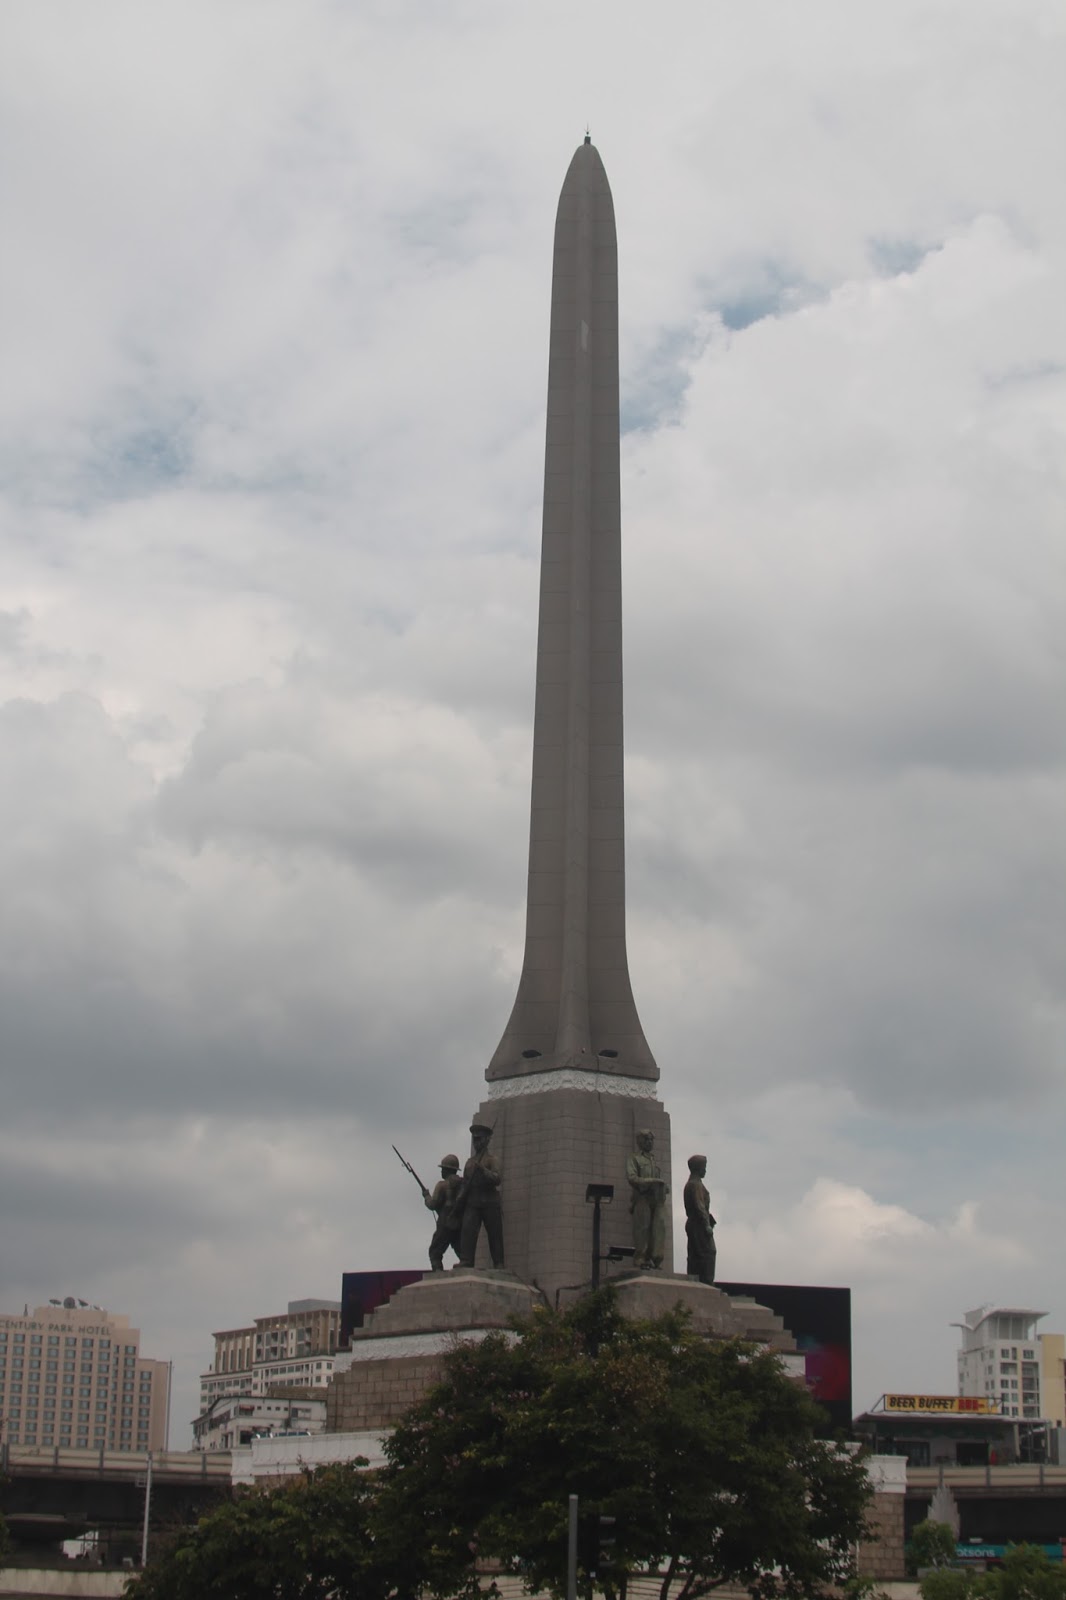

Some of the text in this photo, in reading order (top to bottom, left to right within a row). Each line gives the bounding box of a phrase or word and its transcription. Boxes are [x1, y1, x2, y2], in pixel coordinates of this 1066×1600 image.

[48, 1323, 73, 1333] PARK
[78, 1325, 112, 1336] HOTEL
[889, 1396, 916, 1408] BEER
[918, 1398, 957, 1410] BUFFET
[955, 1548, 996, 1558] atsons
